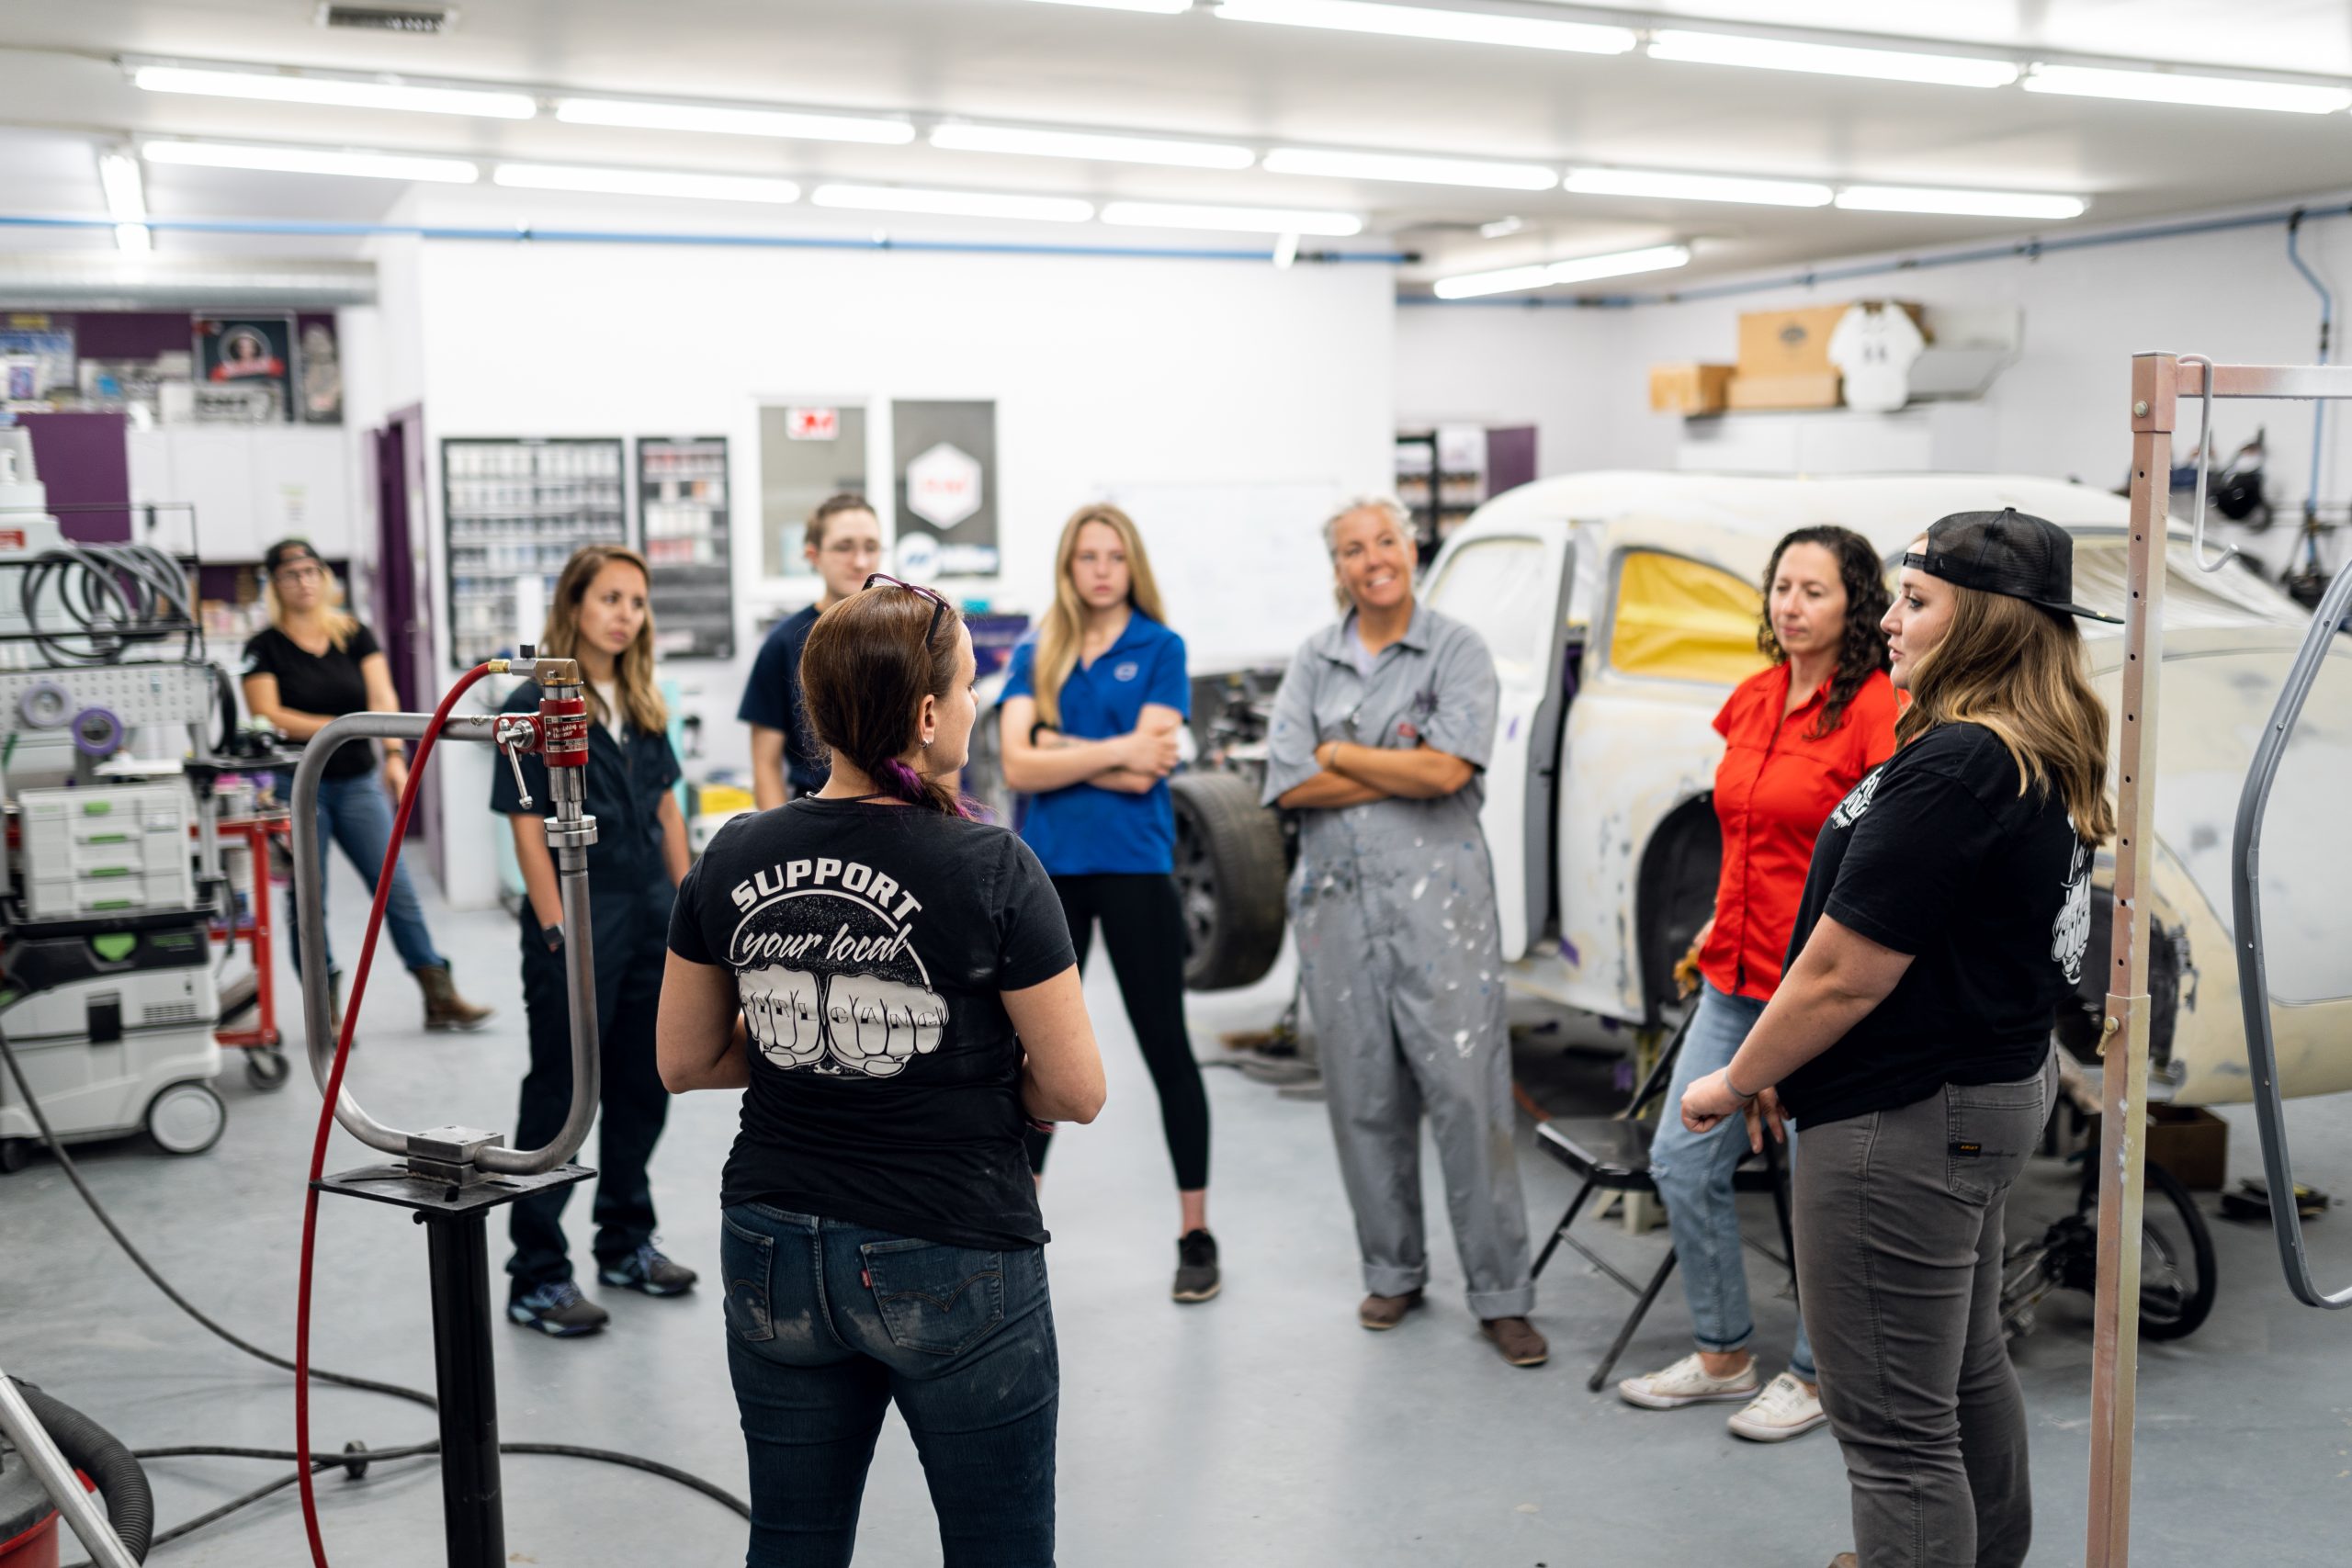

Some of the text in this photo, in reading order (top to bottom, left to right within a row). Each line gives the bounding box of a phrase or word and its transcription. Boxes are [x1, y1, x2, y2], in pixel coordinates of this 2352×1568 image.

[731, 857, 922, 921] SUPPORT
[722, 922, 913, 966] your local
[830, 1006, 941, 1029] GANG
